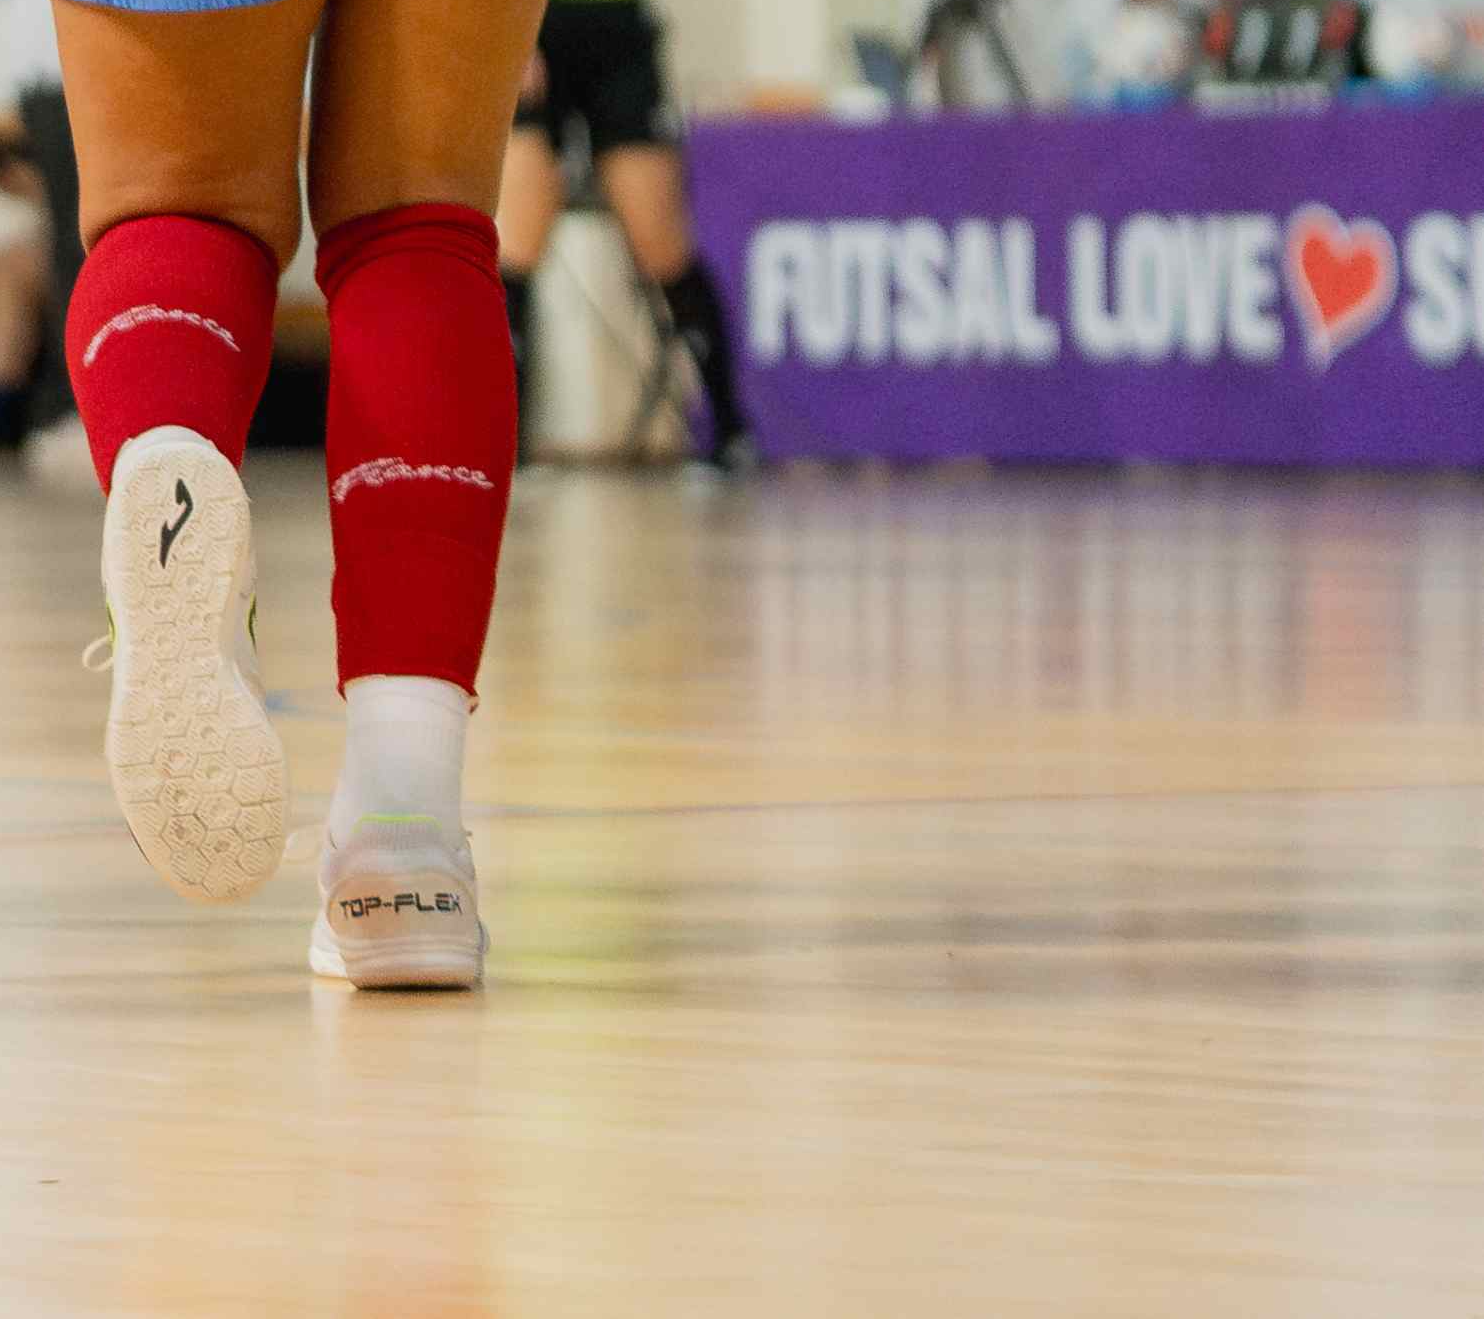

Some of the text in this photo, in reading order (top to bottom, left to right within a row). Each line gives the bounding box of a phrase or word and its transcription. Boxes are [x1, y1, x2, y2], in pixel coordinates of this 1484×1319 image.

[749, 219, 1057, 361] FUTSAL
[1069, 213, 1282, 359] LOVE
[340, 891, 463, 918] TOP-FLEX
